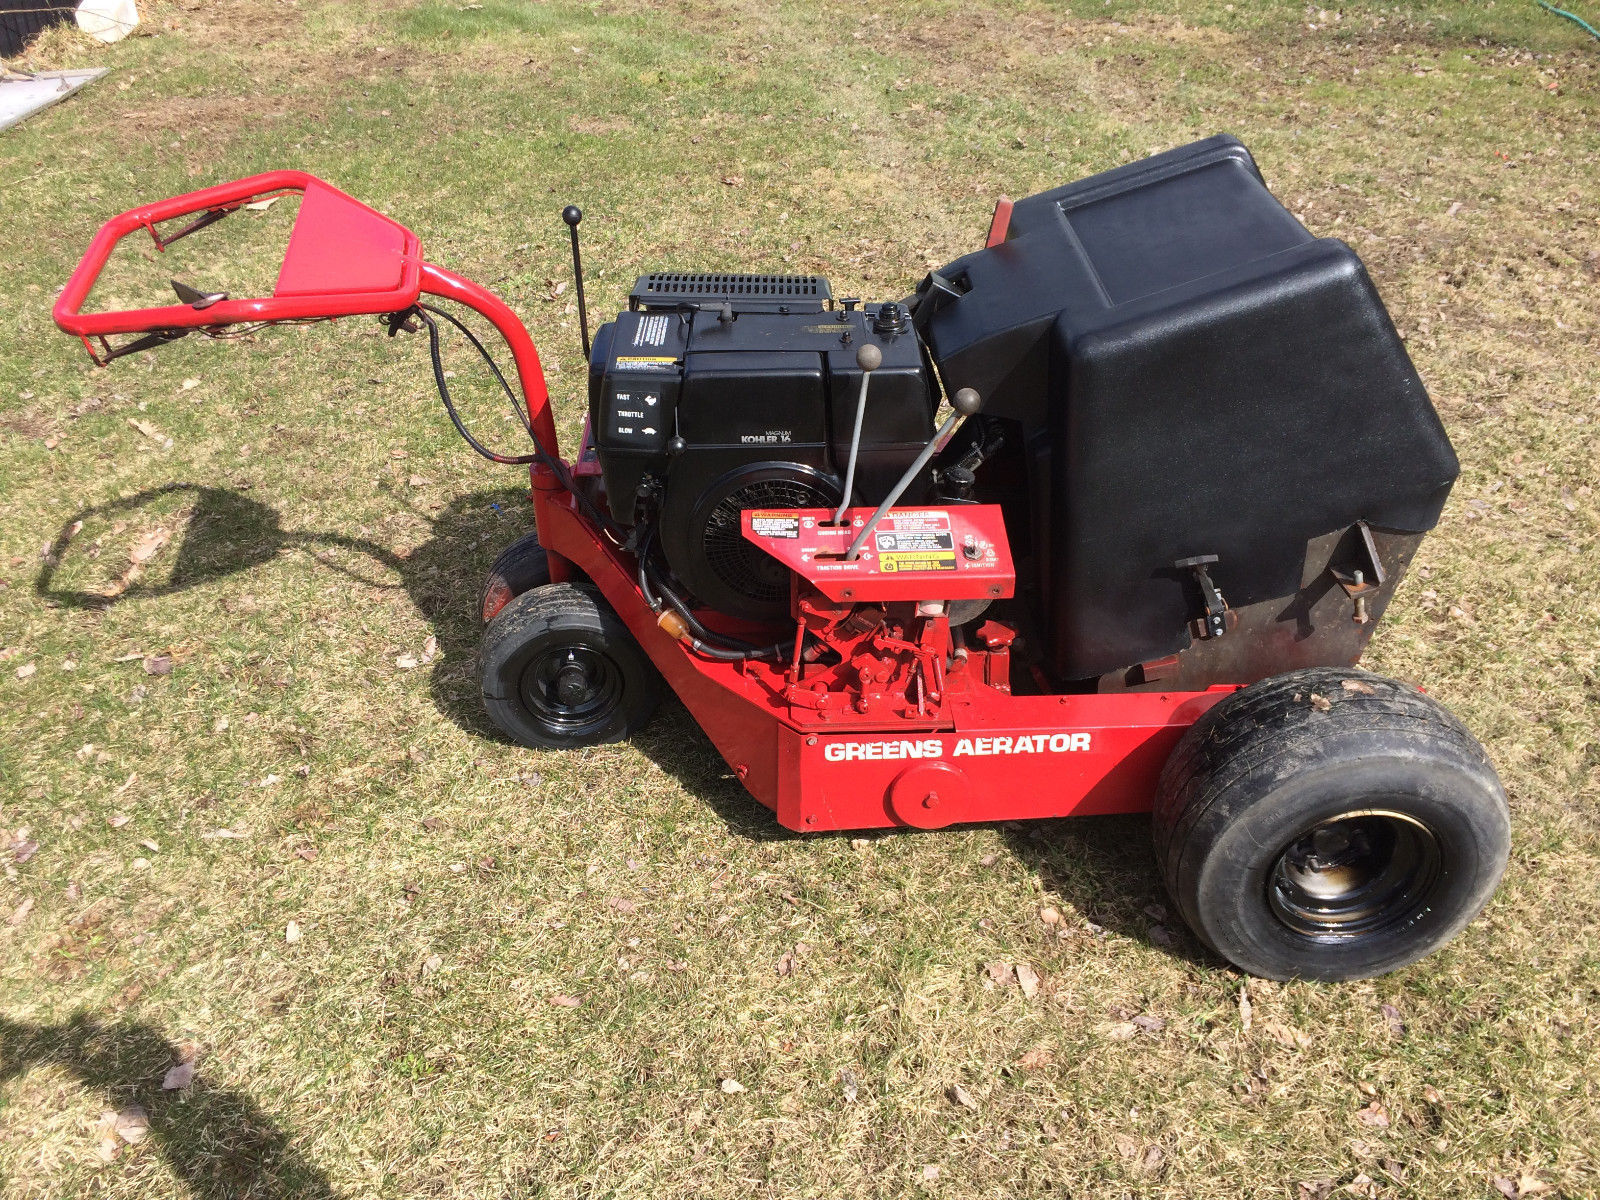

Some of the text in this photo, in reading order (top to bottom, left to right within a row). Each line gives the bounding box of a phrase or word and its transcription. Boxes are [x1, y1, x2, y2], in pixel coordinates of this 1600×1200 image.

[741, 435, 792, 443] KOHLER 16
[824, 733, 1092, 762] GREENS AERATOR
